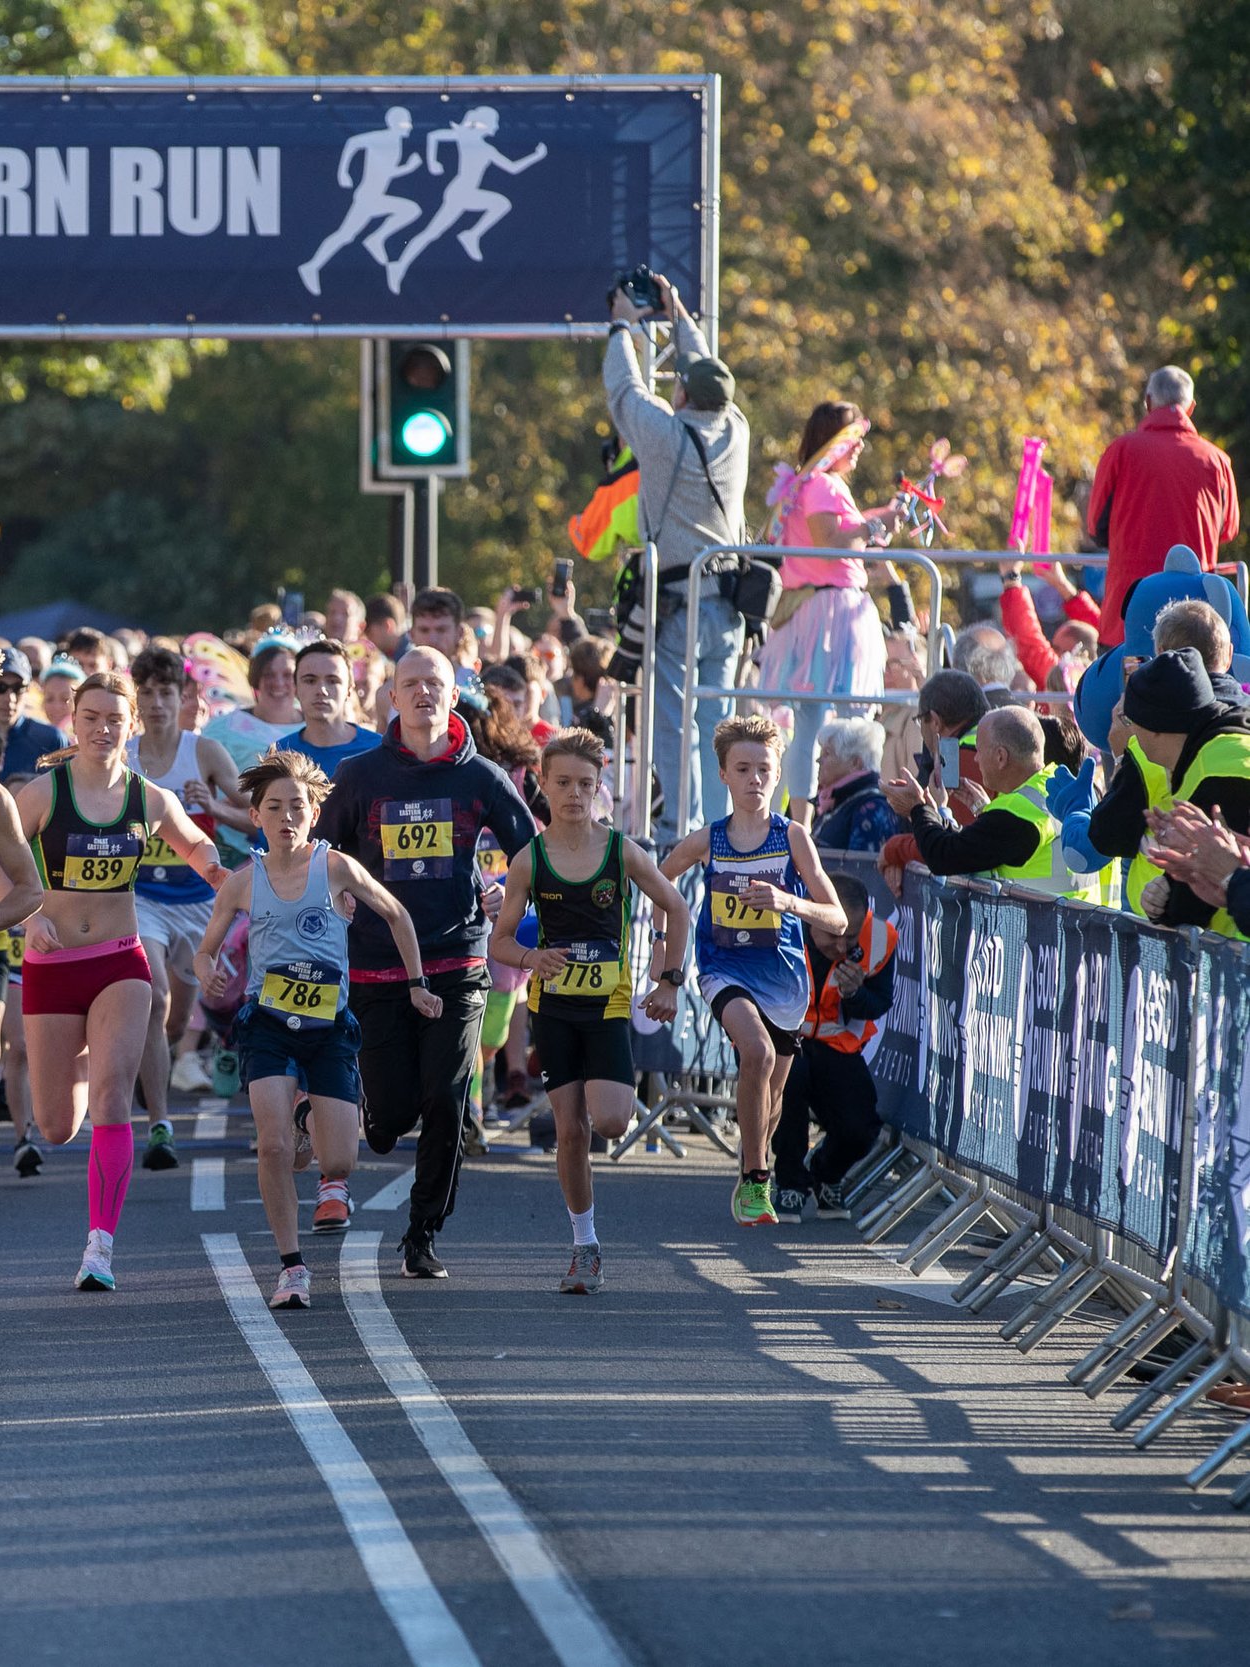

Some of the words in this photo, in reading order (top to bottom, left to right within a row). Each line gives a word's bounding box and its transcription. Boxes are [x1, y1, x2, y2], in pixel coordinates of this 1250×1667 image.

[110, 146, 281, 236] RUN
[397, 824, 437, 850] 692
[81, 859, 123, 881] 839
[118, 936, 139, 949] NIK
[287, 964, 312, 975] EASTERN
[295, 961, 312, 970] GREAT
[562, 963, 603, 988] 778
[279, 978, 322, 1008] 786
